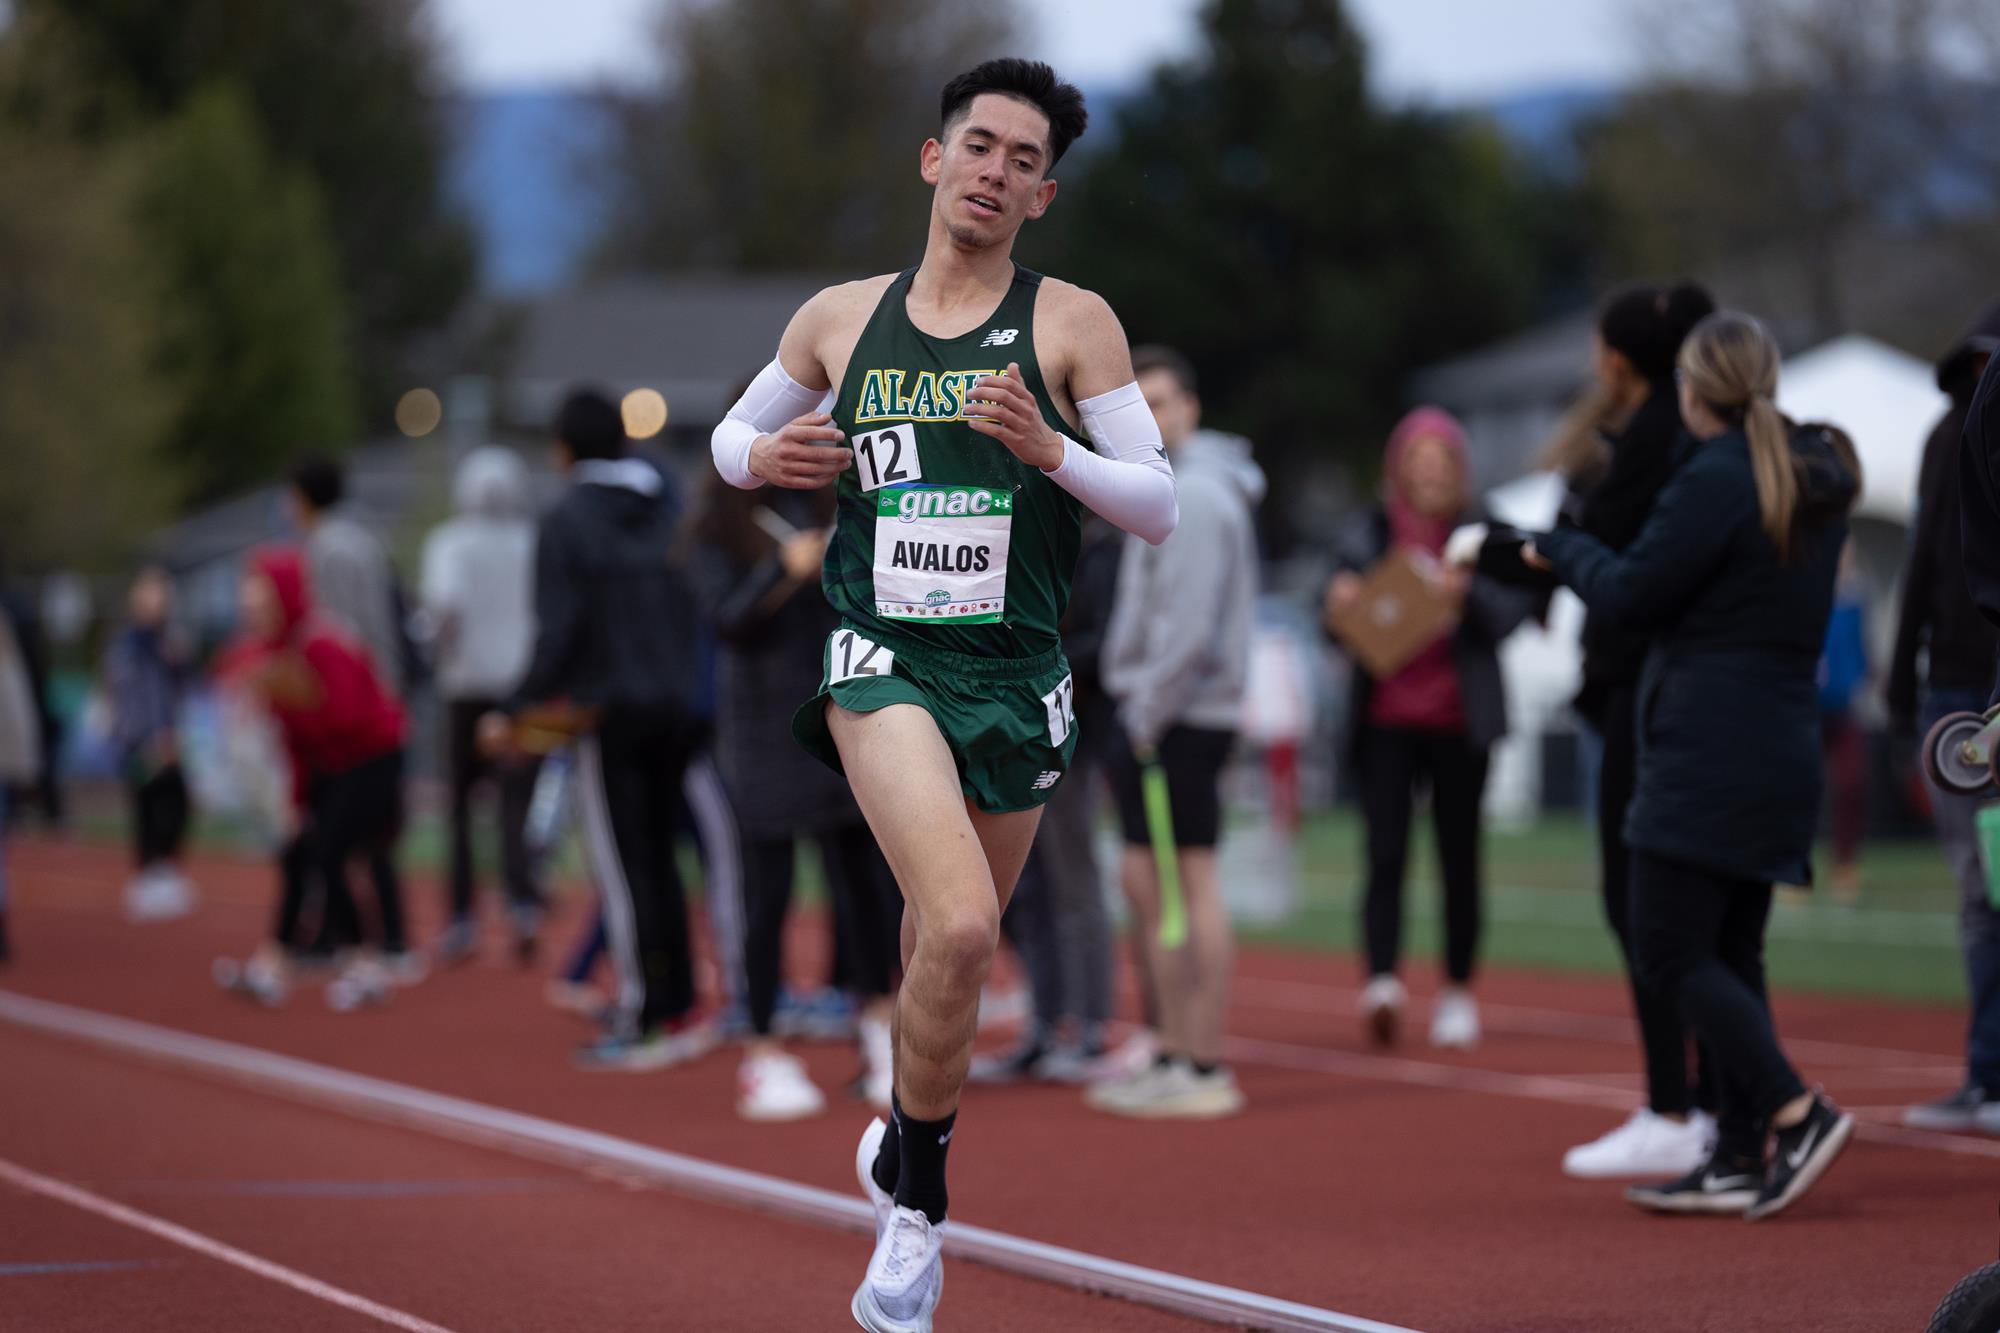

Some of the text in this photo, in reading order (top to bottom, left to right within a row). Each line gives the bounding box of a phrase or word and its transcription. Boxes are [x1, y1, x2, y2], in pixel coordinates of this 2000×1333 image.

[855, 369, 1009, 423] ALAS
[860, 430, 908, 486] 12
[898, 489, 992, 523] gnac
[891, 540, 990, 572] AVALOS
